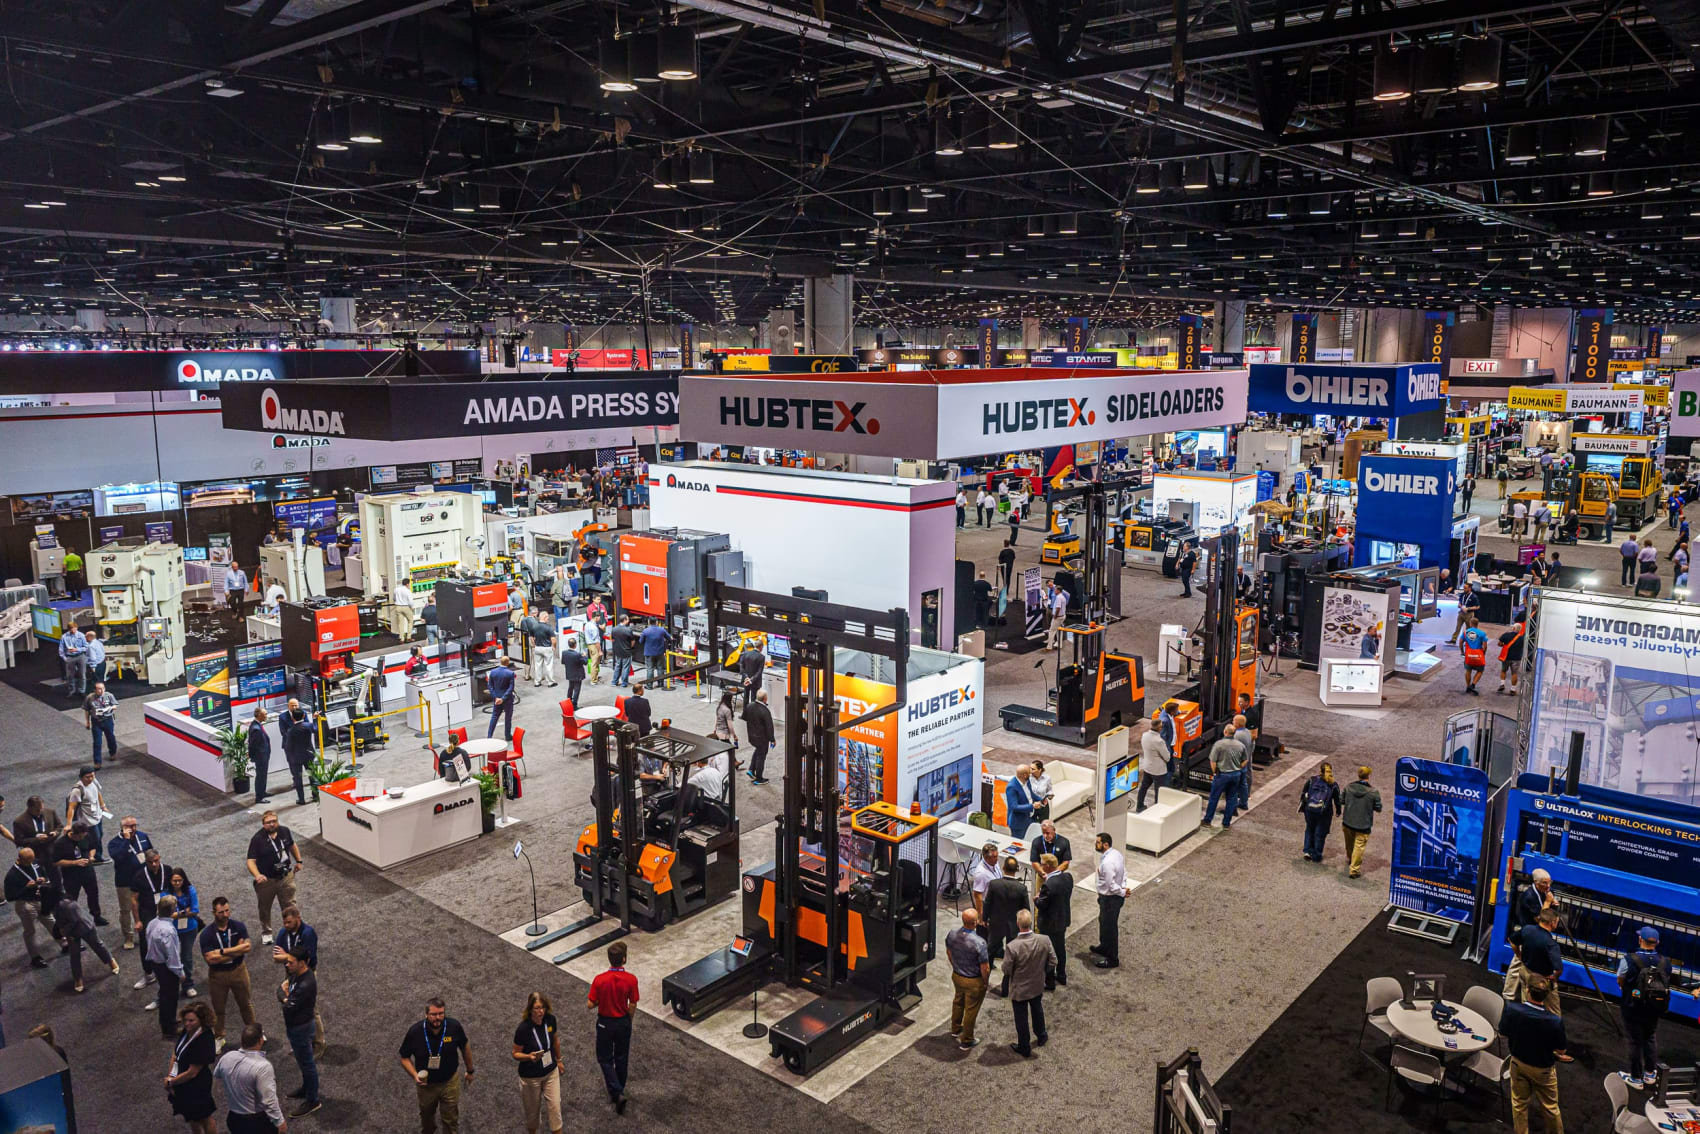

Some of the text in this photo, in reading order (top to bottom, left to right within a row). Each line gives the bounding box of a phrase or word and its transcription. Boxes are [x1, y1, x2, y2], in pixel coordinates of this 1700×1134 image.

[984, 328, 992, 369] 26000
[1585, 322, 1601, 379] 31000
[1066, 355, 1111, 363] STAMTEC
[1468, 361, 1495, 372] EXIT
[177, 359, 276, 382] AMADA
[261, 387, 345, 435] AMADA
[464, 395, 564, 425] AMADA
[571, 391, 649, 418] PRESS
[1106, 386, 1224, 423] SIDELOADERS
[1511, 396, 1554, 408] BAUMANN
[1571, 399, 1628, 409] BAUMANN
[1678, 391, 1700, 417] B
[271, 433, 331, 449] AMADA
[1584, 442, 1629, 451] BAUMANN
[666, 473, 711, 492] AMADA
[850, 725, 885, 740] PARTNER
[908, 707, 975, 739] THE RELIABLE PARTNER
[1420, 779, 1480, 799] ULTRALOX
[434, 797, 475, 815] AMADA
[1546, 802, 1700, 842] ULTRALOX INTERLOCKING TECH
[1569, 829, 1599, 840] ALUMINUM
[1609, 838, 1679, 858] ARCHITECTURAL GRADE
[1617, 845, 1670, 861] POWDER COATING
[1394, 883, 1424, 894] ALUMINUM
[1425, 890, 1449, 900] RAILING
[1395, 877, 1432, 891] COMMERCIAL
[1438, 888, 1475, 900] RESIDENTIAL
[1400, 873, 1472, 894] PREMIUM POWDER COATED
